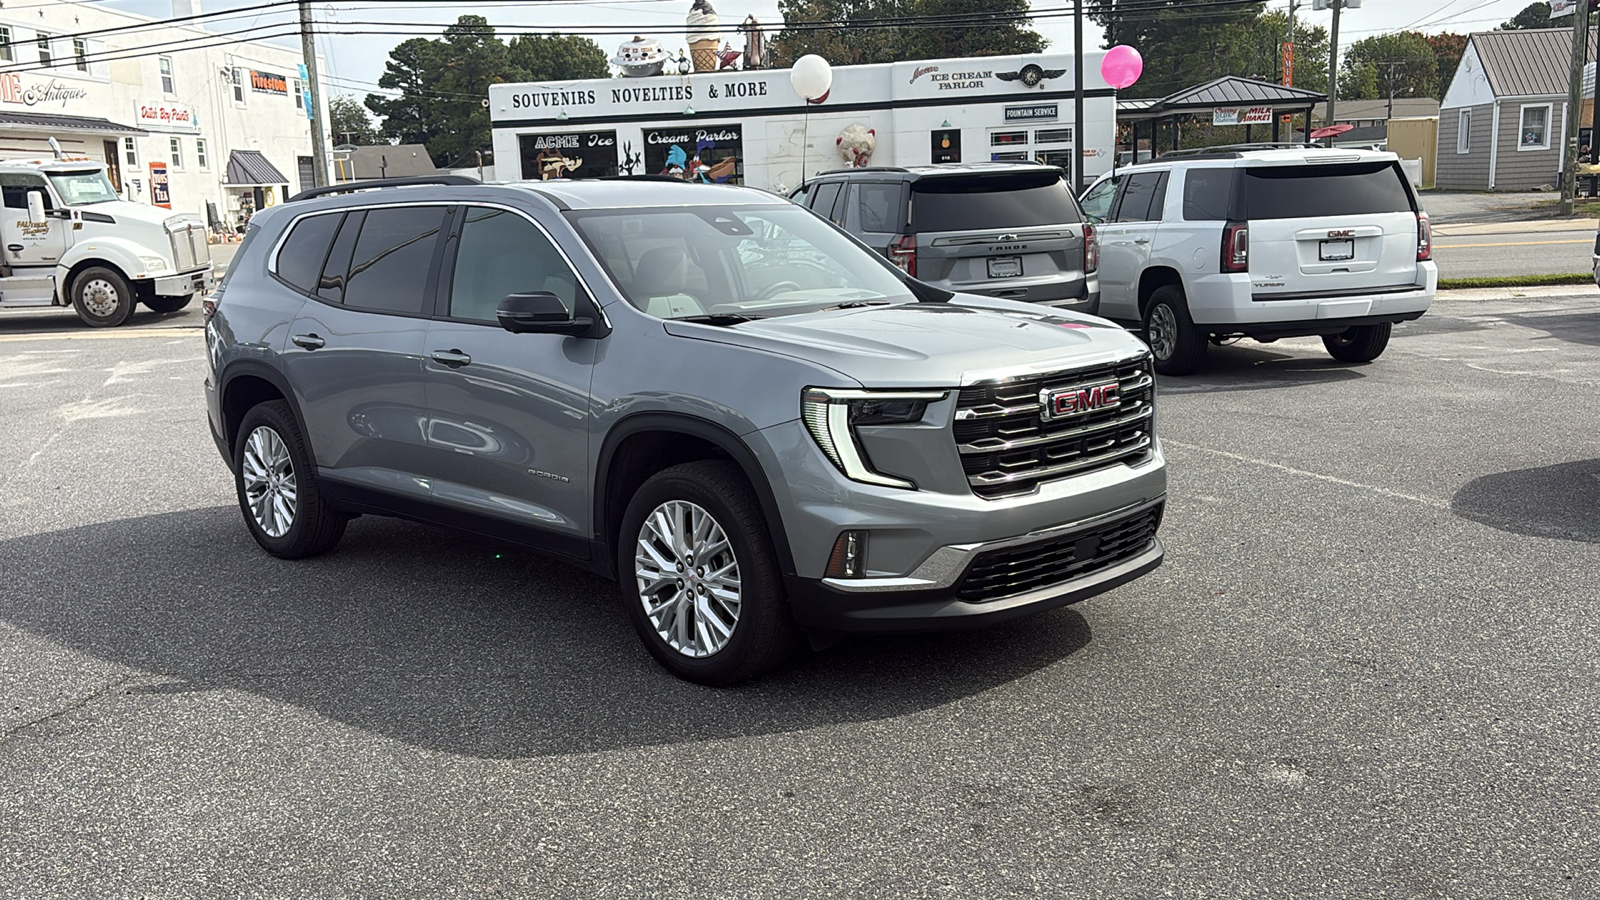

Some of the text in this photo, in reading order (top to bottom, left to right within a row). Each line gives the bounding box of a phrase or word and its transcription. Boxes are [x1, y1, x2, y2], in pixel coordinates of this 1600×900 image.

[1284, 44, 1292, 76] ACME
[931, 71, 993, 82] ICE CREAM
[23, 78, 88, 108] Antiques
[938, 81, 984, 90] PARLOR
[513, 81, 768, 108] SOUVENIRS NOVELTIES & MORE
[1007, 107, 1056, 118] FOUNTAIN SERVICE
[1242, 114, 1271, 122] SHAKES
[535, 134, 615, 149] ACME Ice
[647, 129, 739, 145] Cream Parlor
[1327, 230, 1356, 238] GMC
[1054, 383, 1120, 415] GMC
